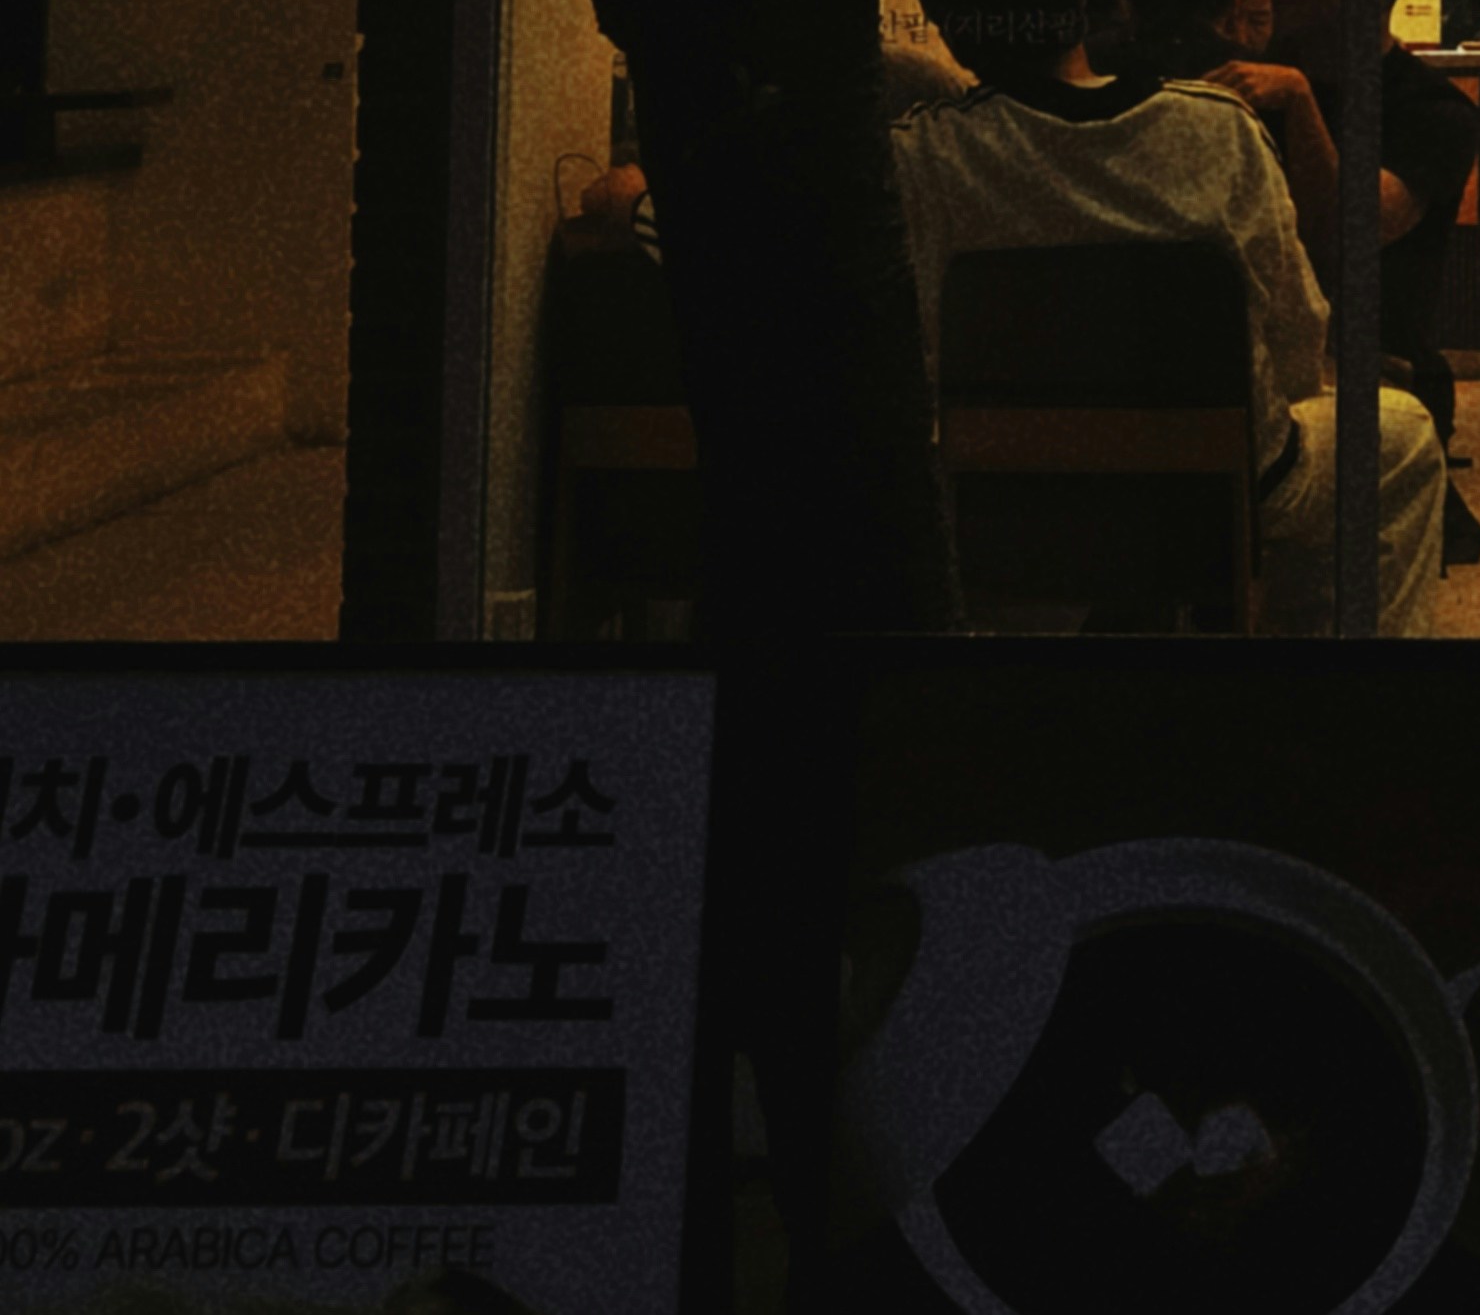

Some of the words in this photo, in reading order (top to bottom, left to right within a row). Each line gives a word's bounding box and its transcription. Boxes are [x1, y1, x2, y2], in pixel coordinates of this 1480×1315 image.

[0, 753, 617, 860] 치·에스프레소
[95, 1225, 297, 1270] ARABICA
[314, 1224, 497, 1269] COFFEE
